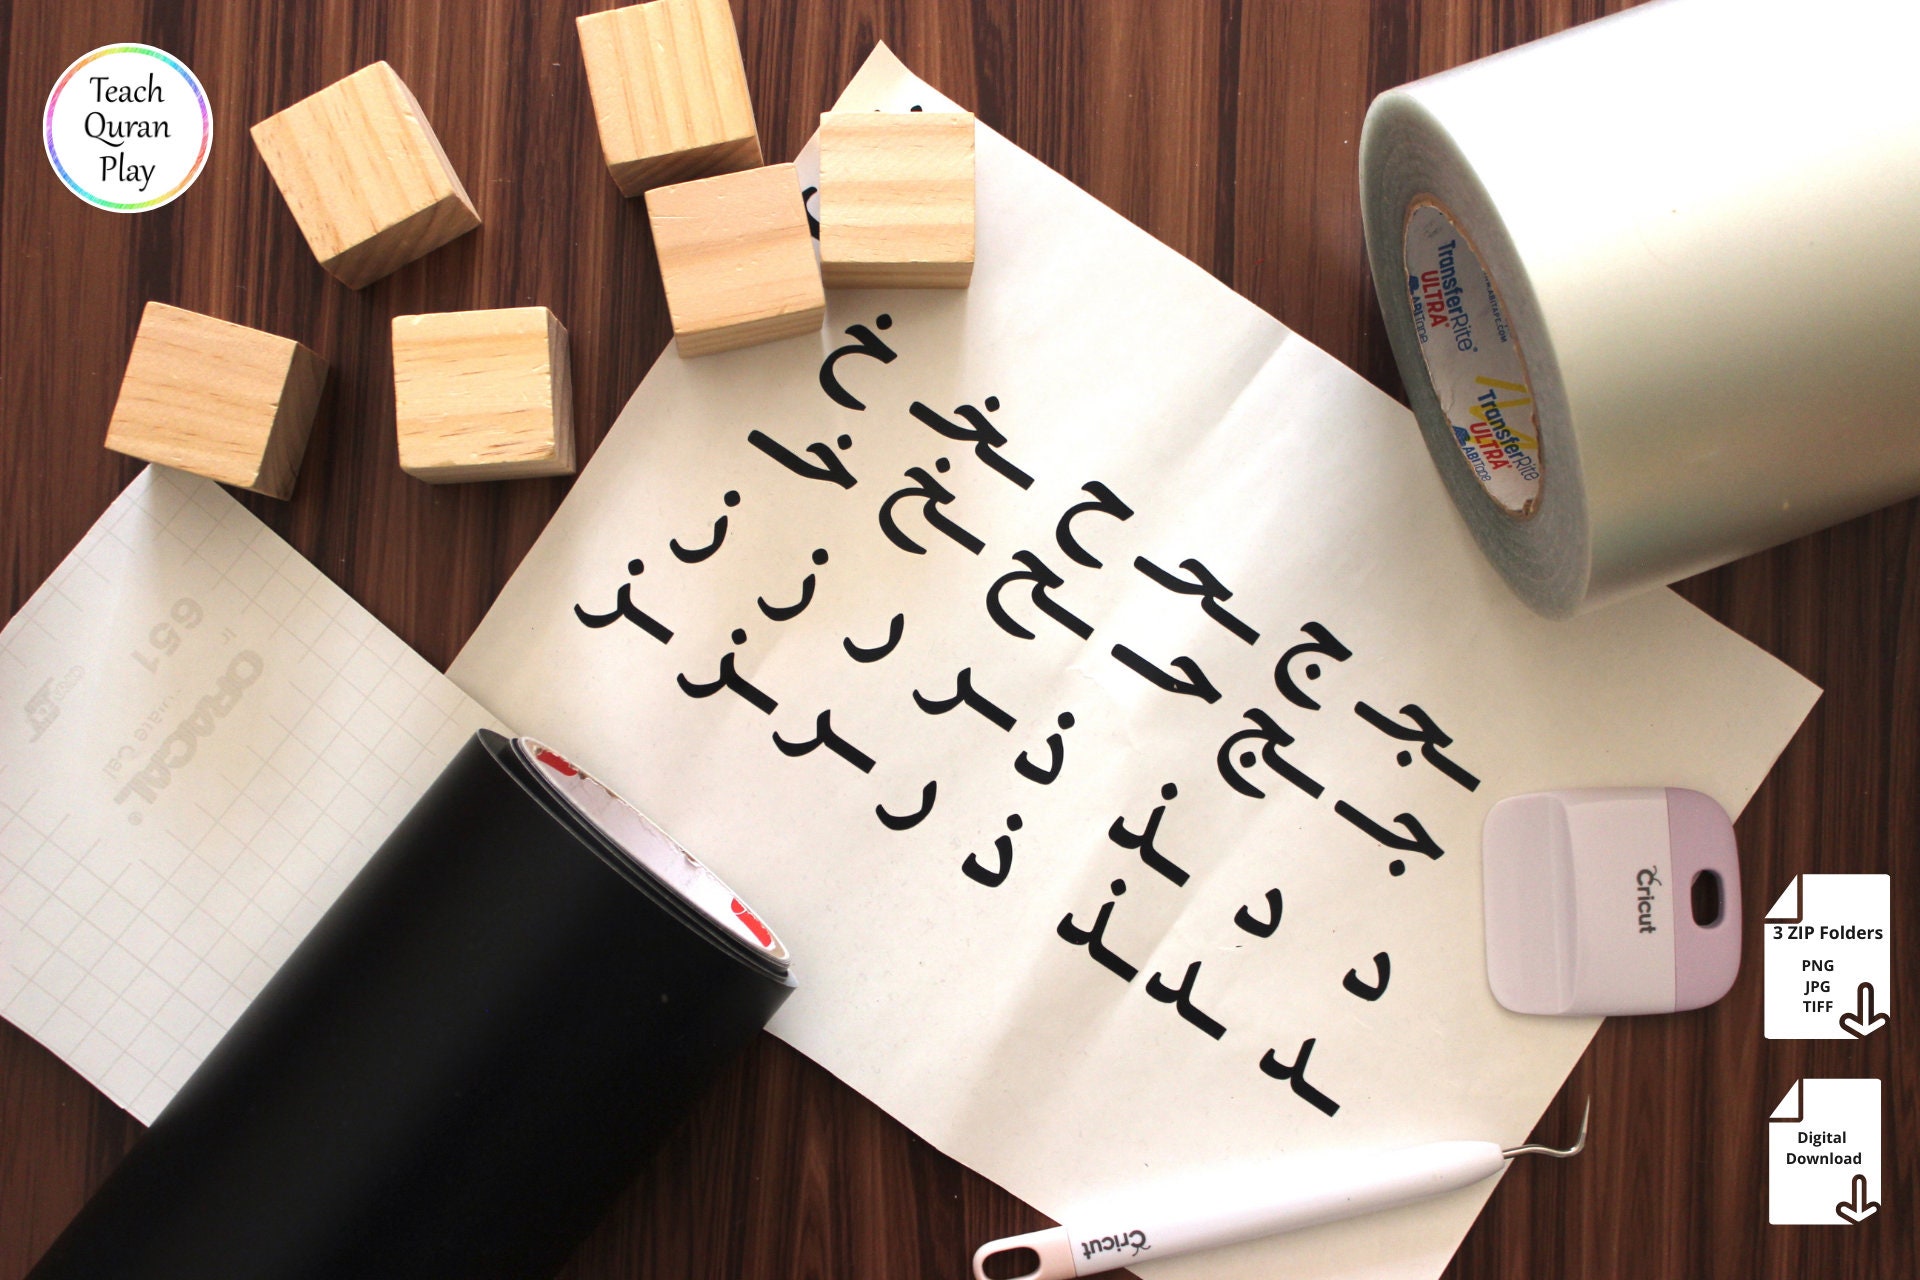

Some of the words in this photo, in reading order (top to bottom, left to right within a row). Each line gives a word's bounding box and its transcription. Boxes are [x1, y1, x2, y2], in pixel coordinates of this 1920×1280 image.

[130, 597, 204, 675] 651
[1636, 865, 1663, 934] Cricut
[1081, 1229, 1151, 1260] Cricut
